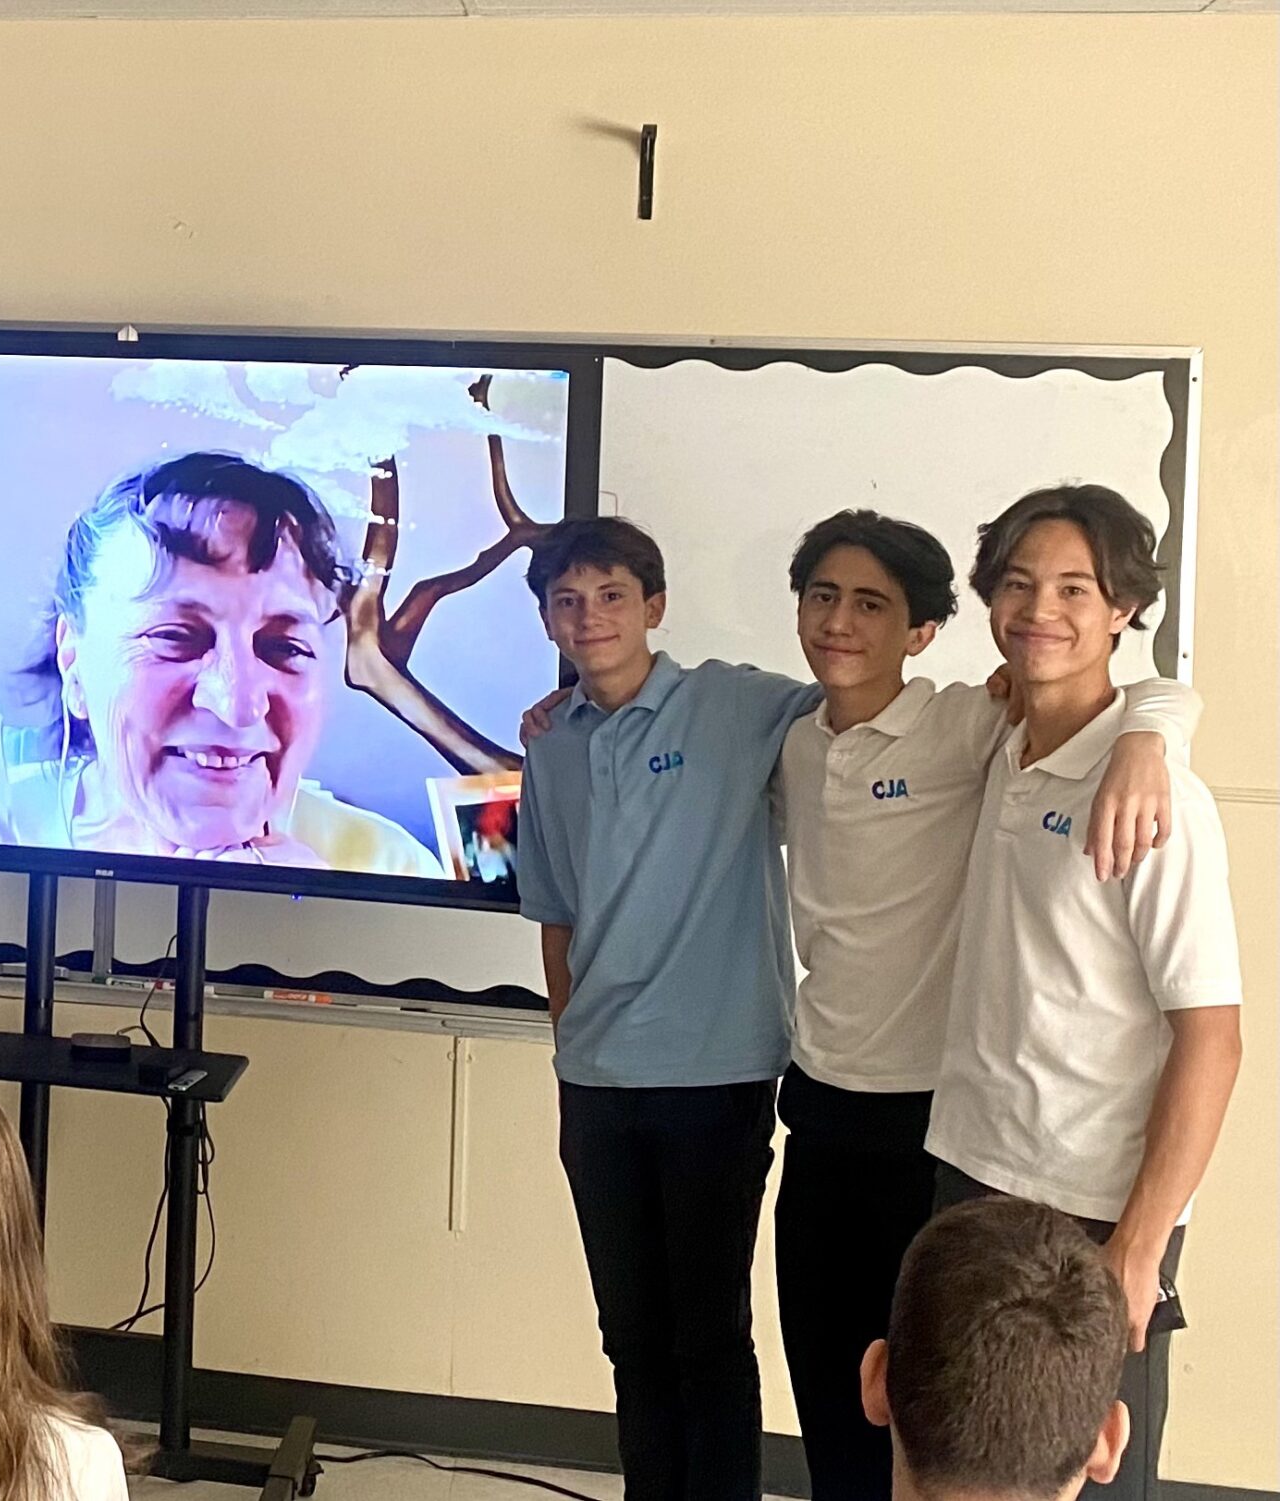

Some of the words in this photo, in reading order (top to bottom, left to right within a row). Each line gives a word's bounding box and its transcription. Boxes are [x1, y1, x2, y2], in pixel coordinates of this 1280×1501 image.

[648, 751, 684, 774] CJA
[871, 778, 909, 800] CJA
[1042, 811, 1072, 838] CJA
